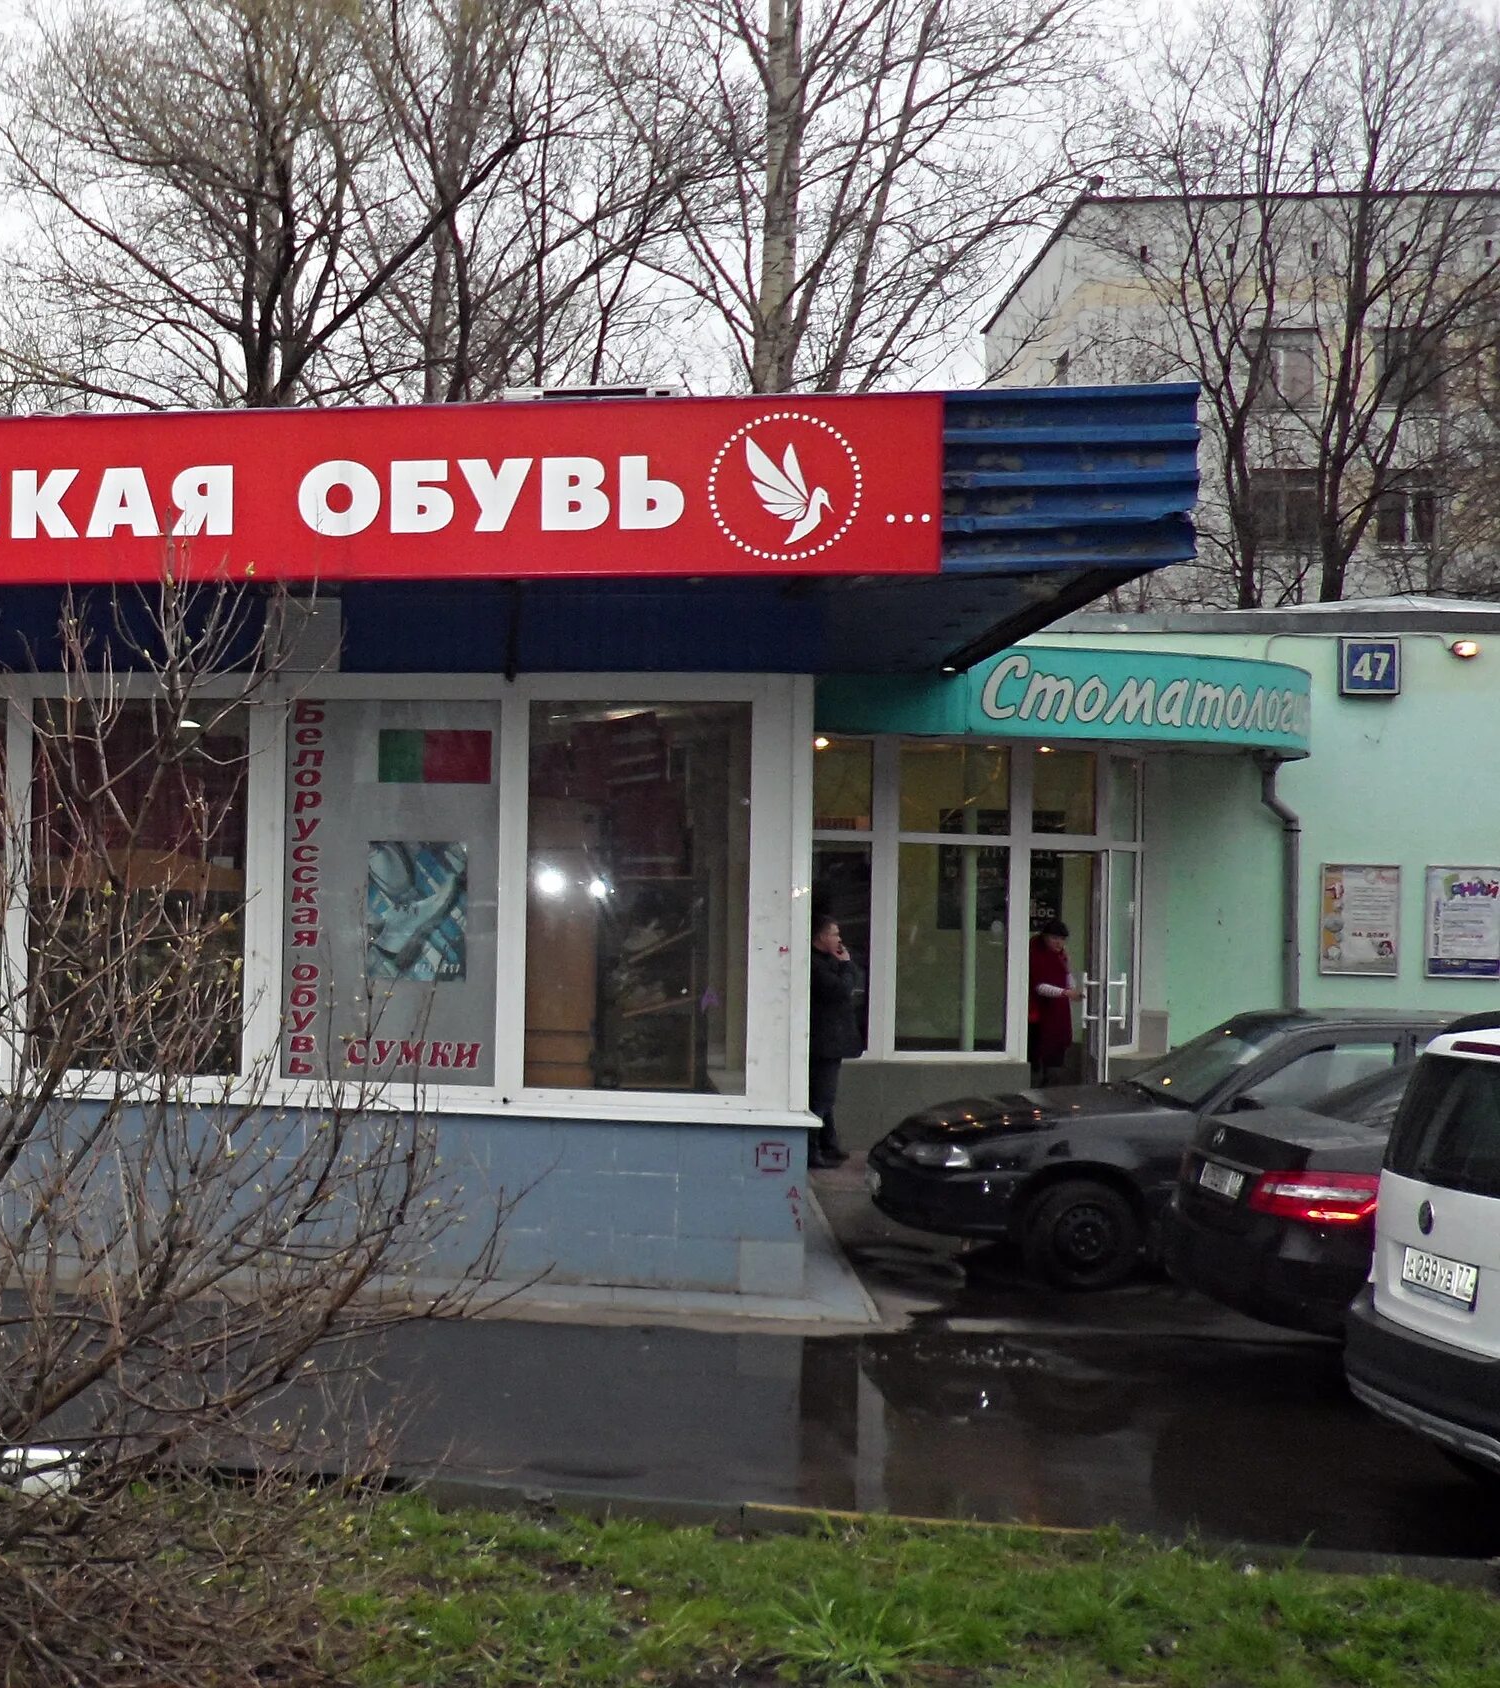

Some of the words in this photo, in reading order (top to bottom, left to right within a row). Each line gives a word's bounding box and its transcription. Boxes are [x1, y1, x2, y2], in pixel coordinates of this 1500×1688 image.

[298, 455, 685, 536] ОБУВЬ
[1352, 652, 1390, 681] 47
[291, 702, 326, 949] Белорусская
[287, 963, 320, 1076] обувь
